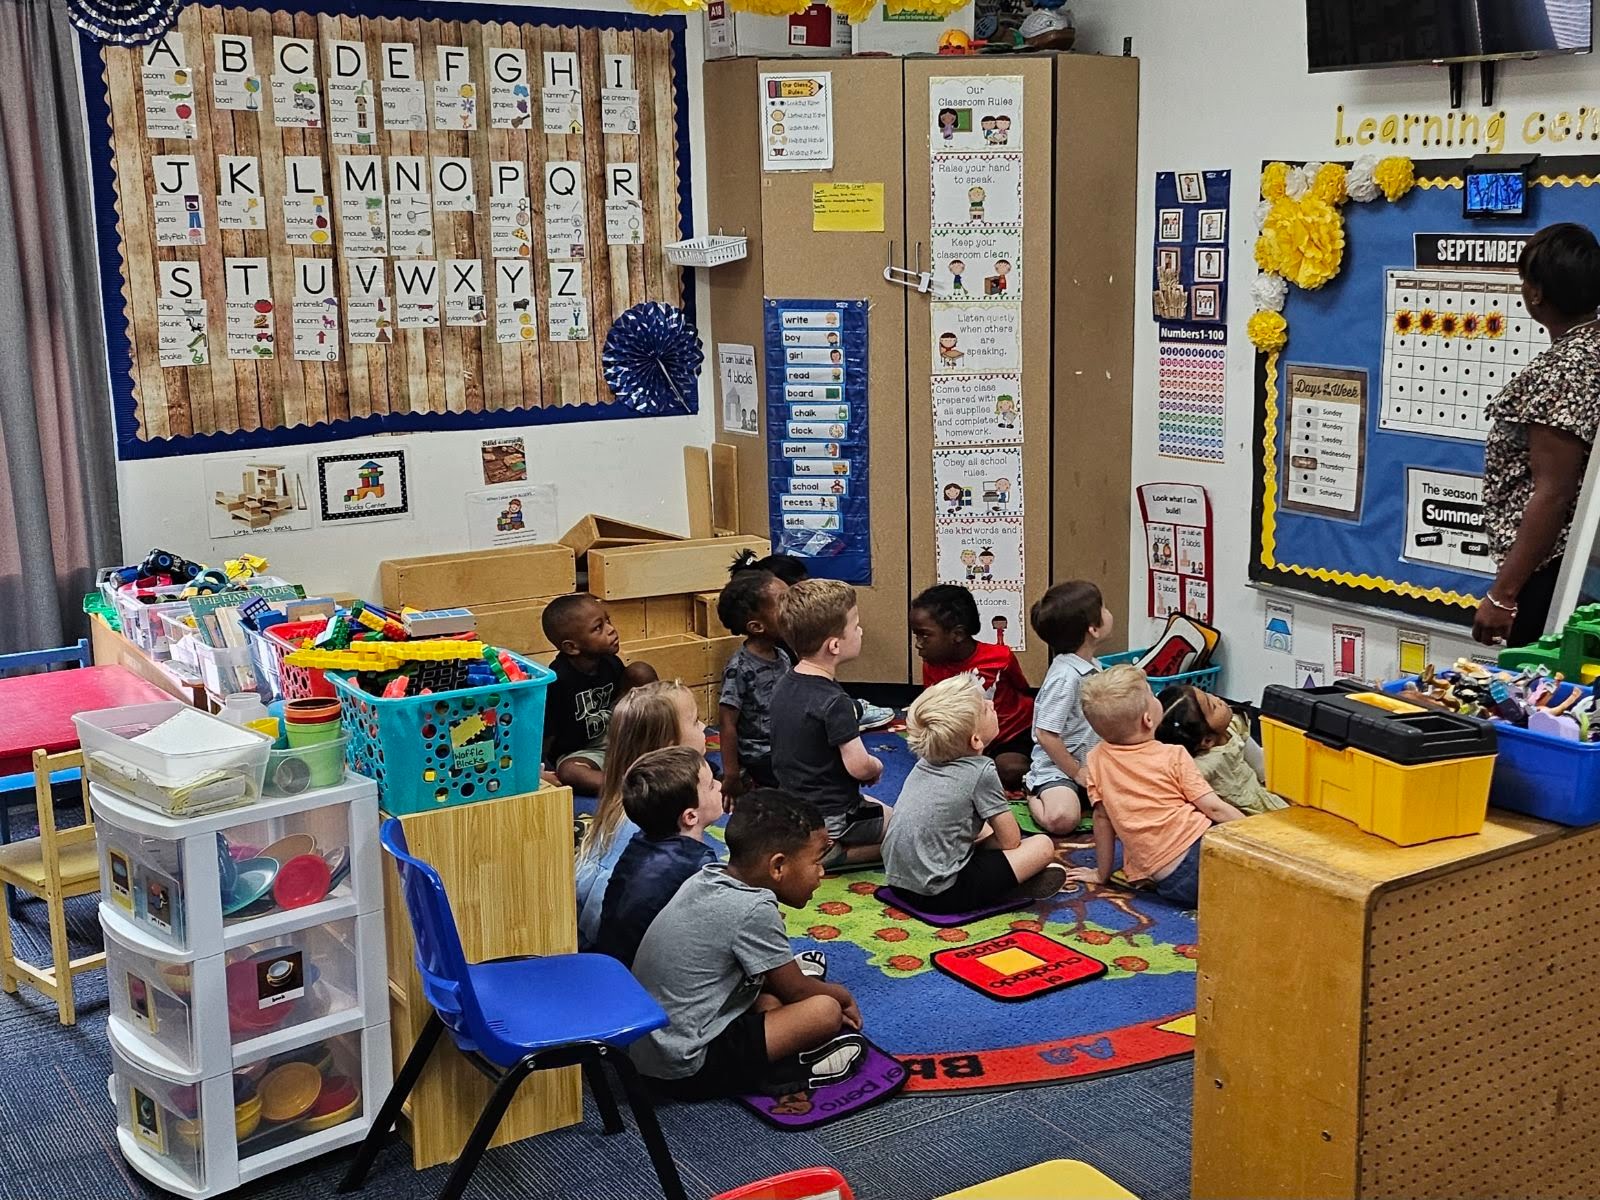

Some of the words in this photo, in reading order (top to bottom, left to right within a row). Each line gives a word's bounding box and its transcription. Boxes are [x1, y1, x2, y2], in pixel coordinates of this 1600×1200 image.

[710, 5, 722, 17] A18
[148, 38, 180, 66] A
[222, 40, 248, 73] B
[280, 42, 308, 74] C
[336, 45, 361, 76] D
[388, 48, 409, 79] E
[446, 52, 464, 81] F
[494, 54, 522, 83] G
[552, 58, 573, 86] H
[614, 60, 623, 88] I
[966, 86, 985, 94] Our
[216, 96, 233, 104] boat
[330, 98, 343, 107] dog
[938, 98, 985, 106] Classroom
[988, 98, 1013, 106] Rules
[147, 106, 166, 114] apple
[1334, 104, 1506, 154] Learning
[345, 160, 376, 191] M
[939, 164, 963, 173] Raise
[965, 166, 986, 176] your
[988, 164, 1010, 172] hand
[160, 162, 189, 193] J
[229, 162, 254, 194] K
[292, 162, 316, 193] L
[396, 162, 420, 191] N
[440, 162, 467, 191] O
[499, 166, 519, 194] P
[550, 167, 576, 196] Q
[614, 168, 634, 196] R
[954, 176, 963, 184] to
[966, 176, 996, 186] speak.
[287, 217, 313, 225] ladybug
[952, 238, 974, 249] Keep
[976, 240, 996, 249] your
[937, 251, 981, 259] classroom
[984, 250, 1012, 259] clean.
[170, 267, 193, 298] S
[232, 265, 258, 295] T
[304, 265, 325, 295] U
[356, 265, 377, 294] V
[398, 266, 437, 295] W
[454, 264, 476, 293] X
[502, 266, 524, 294] Y
[558, 268, 577, 296] Z
[160, 320, 181, 328] skunk
[785, 316, 808, 324] write
[958, 314, 984, 323] Listen
[984, 325, 1013, 333] others
[785, 334, 801, 343] boy
[980, 337, 995, 345] are
[789, 352, 803, 361] girl
[967, 347, 1007, 357] speaking.
[735, 356, 744, 365] build
[728, 368, 732, 382] 4
[734, 372, 753, 384] blocks
[936, 384, 960, 392] Come
[974, 384, 996, 392] class
[1295, 380, 1321, 397] Days
[1331, 384, 1359, 398] Week
[788, 390, 814, 398] board
[937, 395, 976, 405] prepared
[978, 394, 996, 403] with
[794, 409, 816, 417] chalk
[944, 407, 953, 415] all
[956, 406, 990, 416] supplies
[1322, 409, 1342, 418] Sunday
[938, 418, 952, 426] and
[954, 416, 999, 427] completed
[1322, 423, 1343, 431] Monday
[946, 428, 992, 437] homework.
[1321, 436, 1342, 445] Tuesday
[786, 446, 806, 454] paint
[1320, 449, 1352, 460] Wednesday
[943, 458, 966, 468] Obey
[968, 458, 978, 466] all
[980, 456, 1007, 465] school
[1320, 462, 1345, 472] Thursday
[796, 464, 811, 472] bus
[964, 469, 988, 477] rules.
[1320, 476, 1336, 484] Friday
[792, 482, 819, 491] school
[1422, 483, 1440, 495] The
[1442, 488, 1478, 501] season
[1320, 489, 1342, 499] Saturday
[366, 502, 387, 510] Center
[1426, 504, 1485, 526] Summer
[786, 518, 805, 526] slide
[1002, 526, 1017, 534] and
[197, 598, 220, 606] THE
[222, 586, 289, 602] HANDMADE
[574, 682, 614, 721] JUST
[456, 758, 485, 768] Blocks
[954, 938, 1018, 959] square
[990, 957, 1082, 988] cuadrado
[1046, 976, 1063, 984] el
[881, 1067, 903, 1087] el
[819, 1082, 881, 1112] perro
